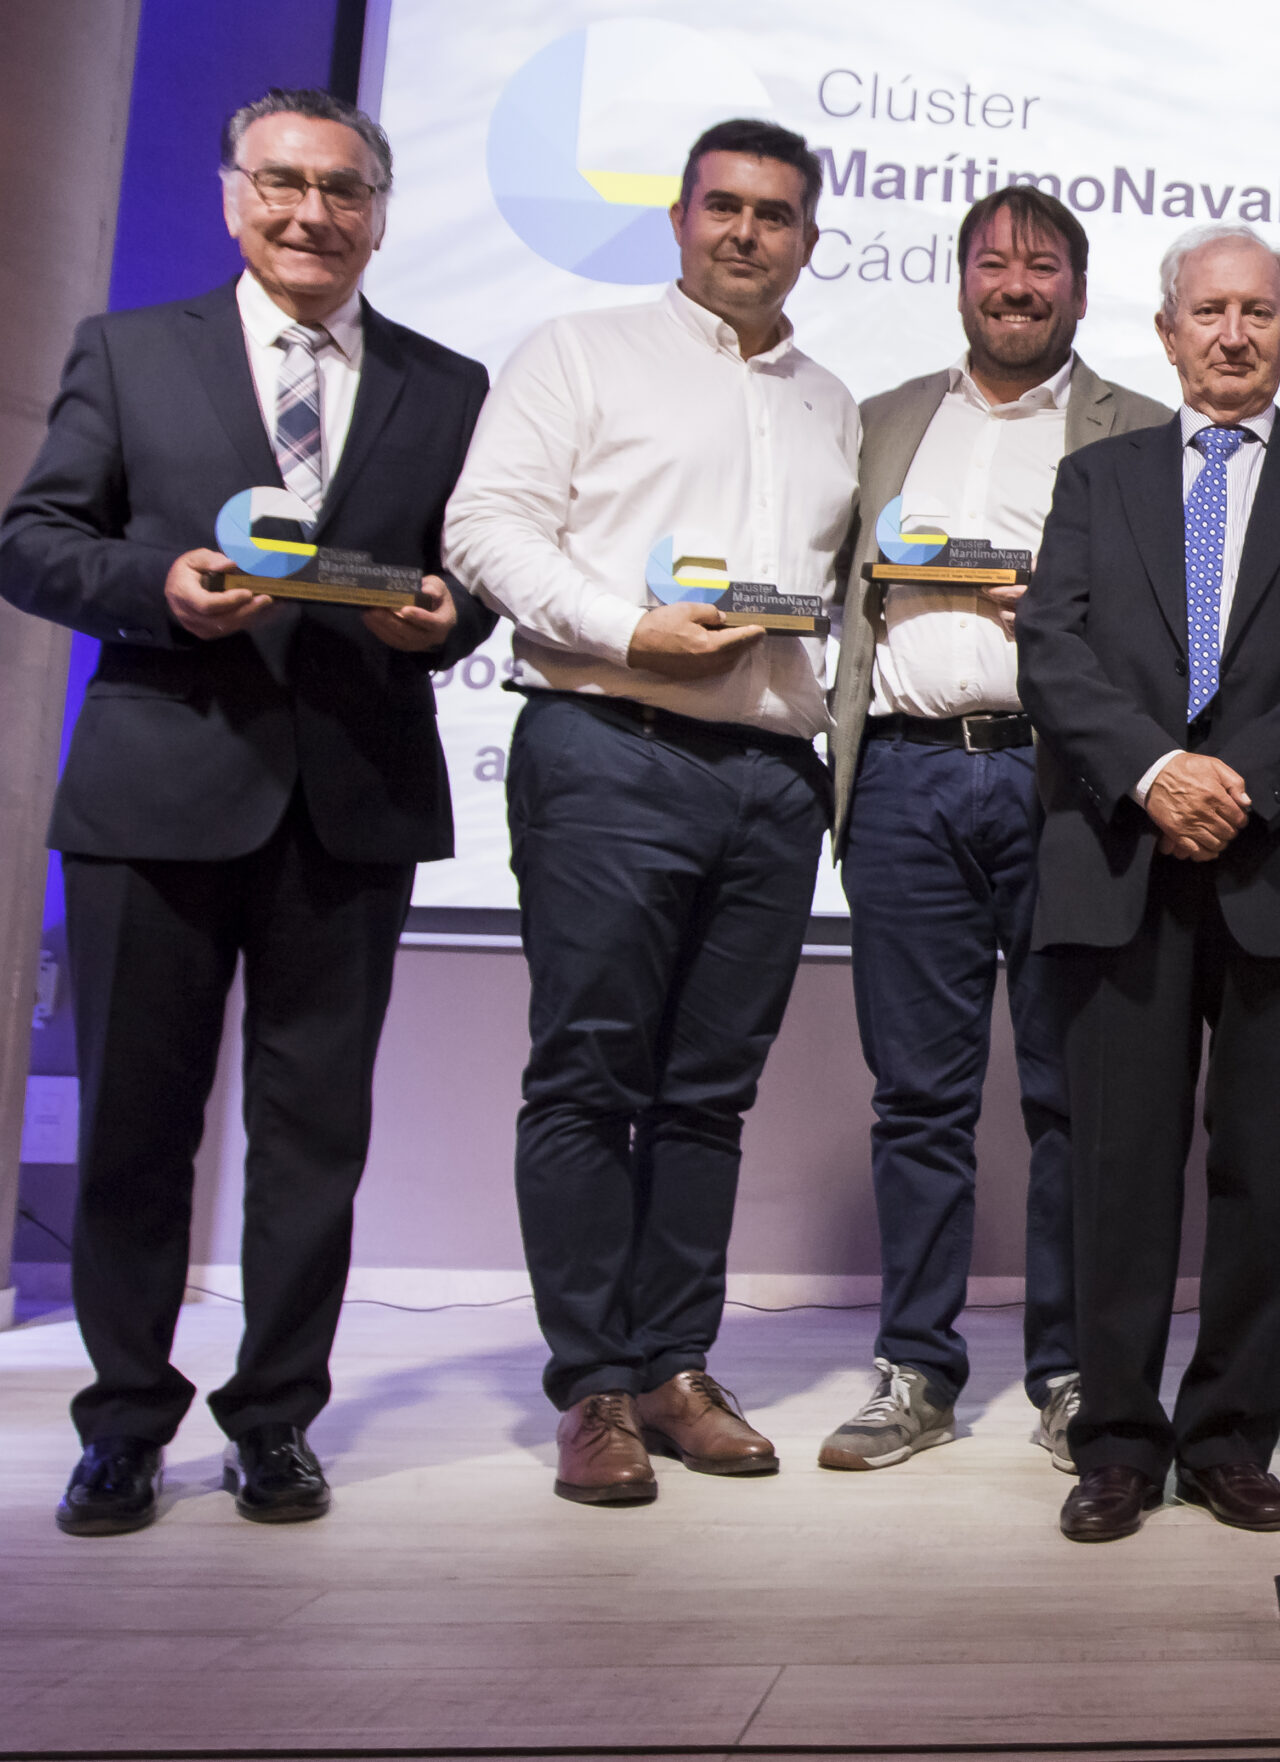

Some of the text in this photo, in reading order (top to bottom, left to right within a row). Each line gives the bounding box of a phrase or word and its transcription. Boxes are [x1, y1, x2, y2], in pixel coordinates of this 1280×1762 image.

[818, 68, 1041, 130] Clúster
[808, 228, 954, 284] Cádi
[1001, 560, 1028, 569] 2024
